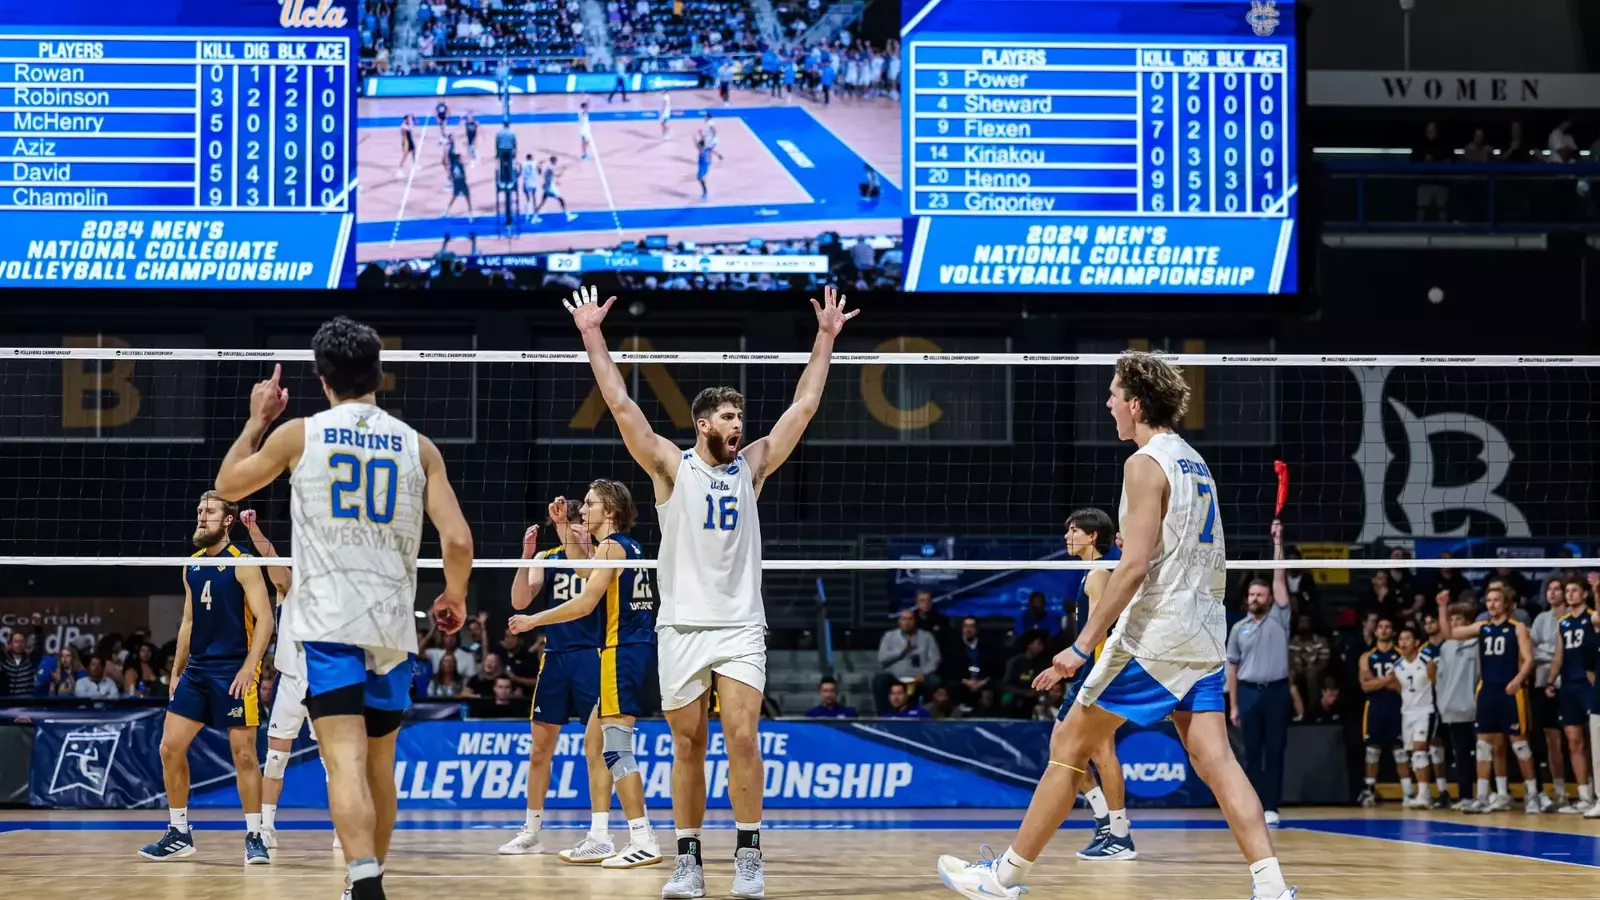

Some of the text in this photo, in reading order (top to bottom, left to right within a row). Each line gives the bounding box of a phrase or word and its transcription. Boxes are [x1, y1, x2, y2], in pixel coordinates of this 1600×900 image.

[279, 0, 347, 28] Ucla
[39, 43, 343, 60] PLAYERS KILL DIG BLK ACE
[982, 50, 1280, 67] PLAYERS KILL DIG BLK ACE
[14, 65, 334, 82] Rowan 0 1 2 1
[938, 70, 1273, 90] 3 Power 0 2 0 0
[14, 89, 334, 107] Robinson 3 2 2 0
[1382, 77, 1541, 101] WOMEN
[938, 94, 1273, 114] 4 Sheward 2 0 0 0
[14, 113, 334, 133] McHenry 5 0 3 0
[938, 119, 1273, 138] 9 Flexen 7 2 0 0
[13, 138, 334, 159] Aziz 0 2 0 0
[930, 146, 948, 159] 14
[1152, 149, 1164, 165] 0
[1188, 149, 1200, 165] 3
[1224, 149, 1237, 165] 0
[1261, 149, 1273, 165] 0
[13, 164, 334, 183] David 5 4 2 0
[929, 170, 1273, 189] 20 Henno 9 5 3 1
[13, 189, 334, 207] Champlin 9 3 1 0
[929, 193, 1273, 212] 23 Grigoriev 6 2 0 0
[81, 221, 224, 240] 2024 MEN'S
[1027, 225, 1167, 245] 2024 MEN'S
[27, 241, 278, 260] NATIONAL COLLEGIATE
[974, 245, 1220, 265] NATIONAL COLLEGIATE
[135, 262, 313, 281] CHAMPIONSHIP
[557, 259, 573, 268] 20
[611, 258, 639, 267] UCLA
[672, 259, 687, 268] 24
[939, 265, 1255, 286] VOLLEYBALL CHAMPIONSHIP
[324, 427, 403, 452] BRUINS
[328, 450, 399, 526] 20
[711, 480, 730, 491] Ucla
[703, 494, 738, 531] 16
[1197, 482, 1216, 546] 7
[200, 580, 212, 611] 4
[553, 573, 587, 600] 20
[2, 613, 102, 625] Cortside
[1484, 635, 1506, 655] 10
[1563, 628, 1585, 649] 13
[457, 732, 532, 755] MEN'S
[394, 761, 578, 798] LLEYBAL
[1122, 762, 1187, 782] NCAA
